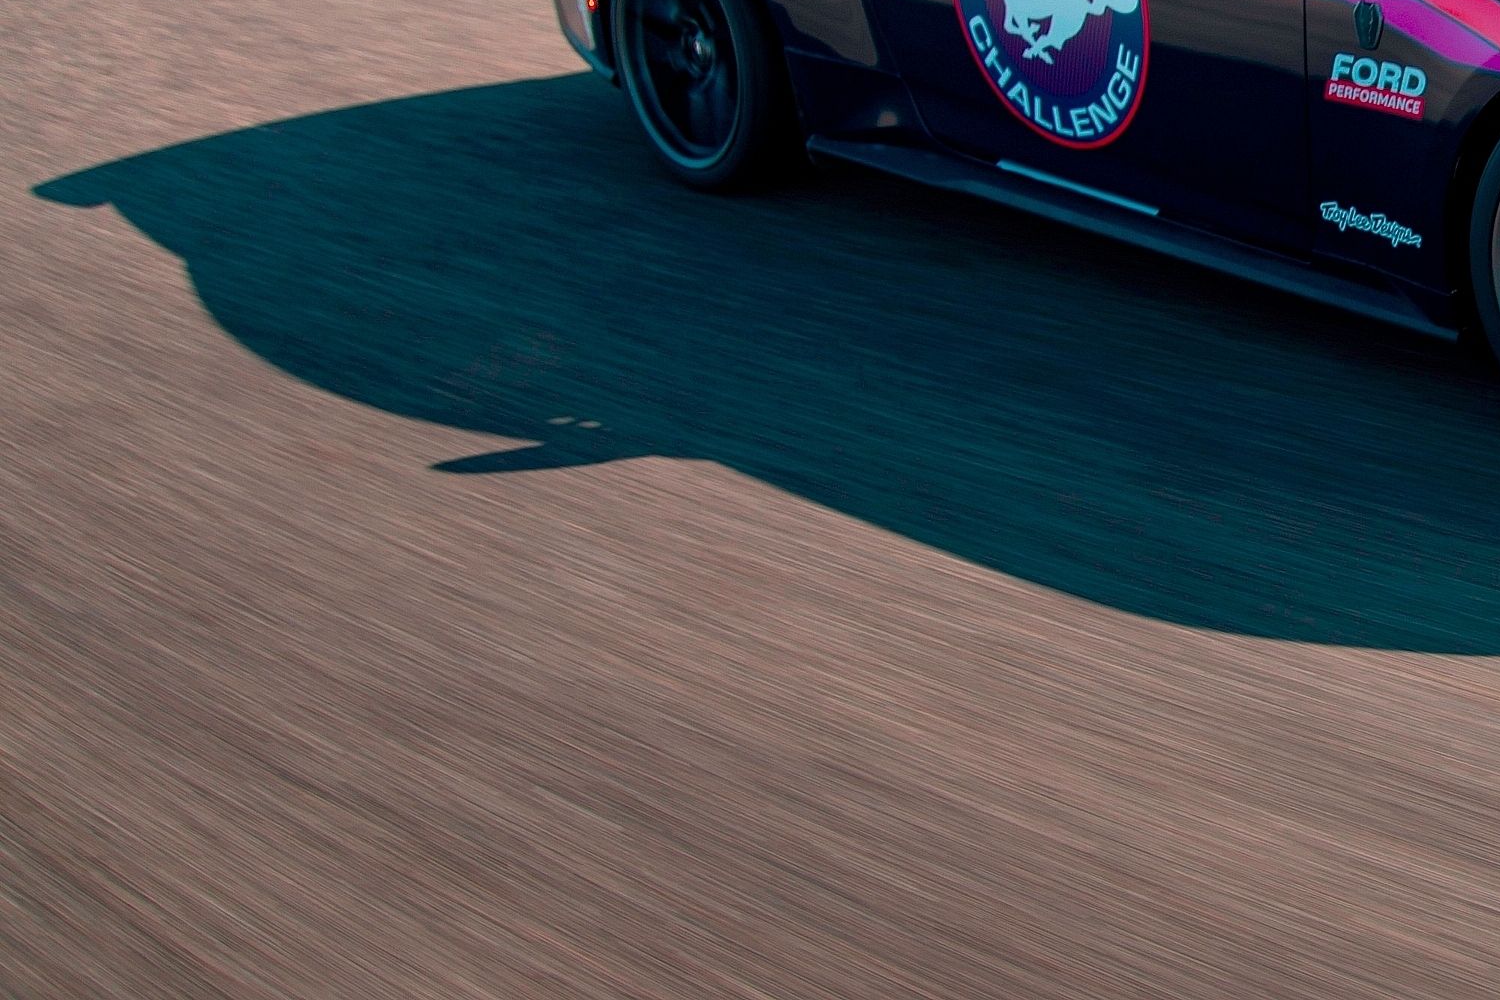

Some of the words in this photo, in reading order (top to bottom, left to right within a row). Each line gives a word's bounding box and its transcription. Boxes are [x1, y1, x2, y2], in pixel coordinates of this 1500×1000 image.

[968, 15, 1139, 138] CHALLENGE
[1330, 52, 1427, 98] FORD
[1327, 82, 1421, 115] PERFORMANCE
